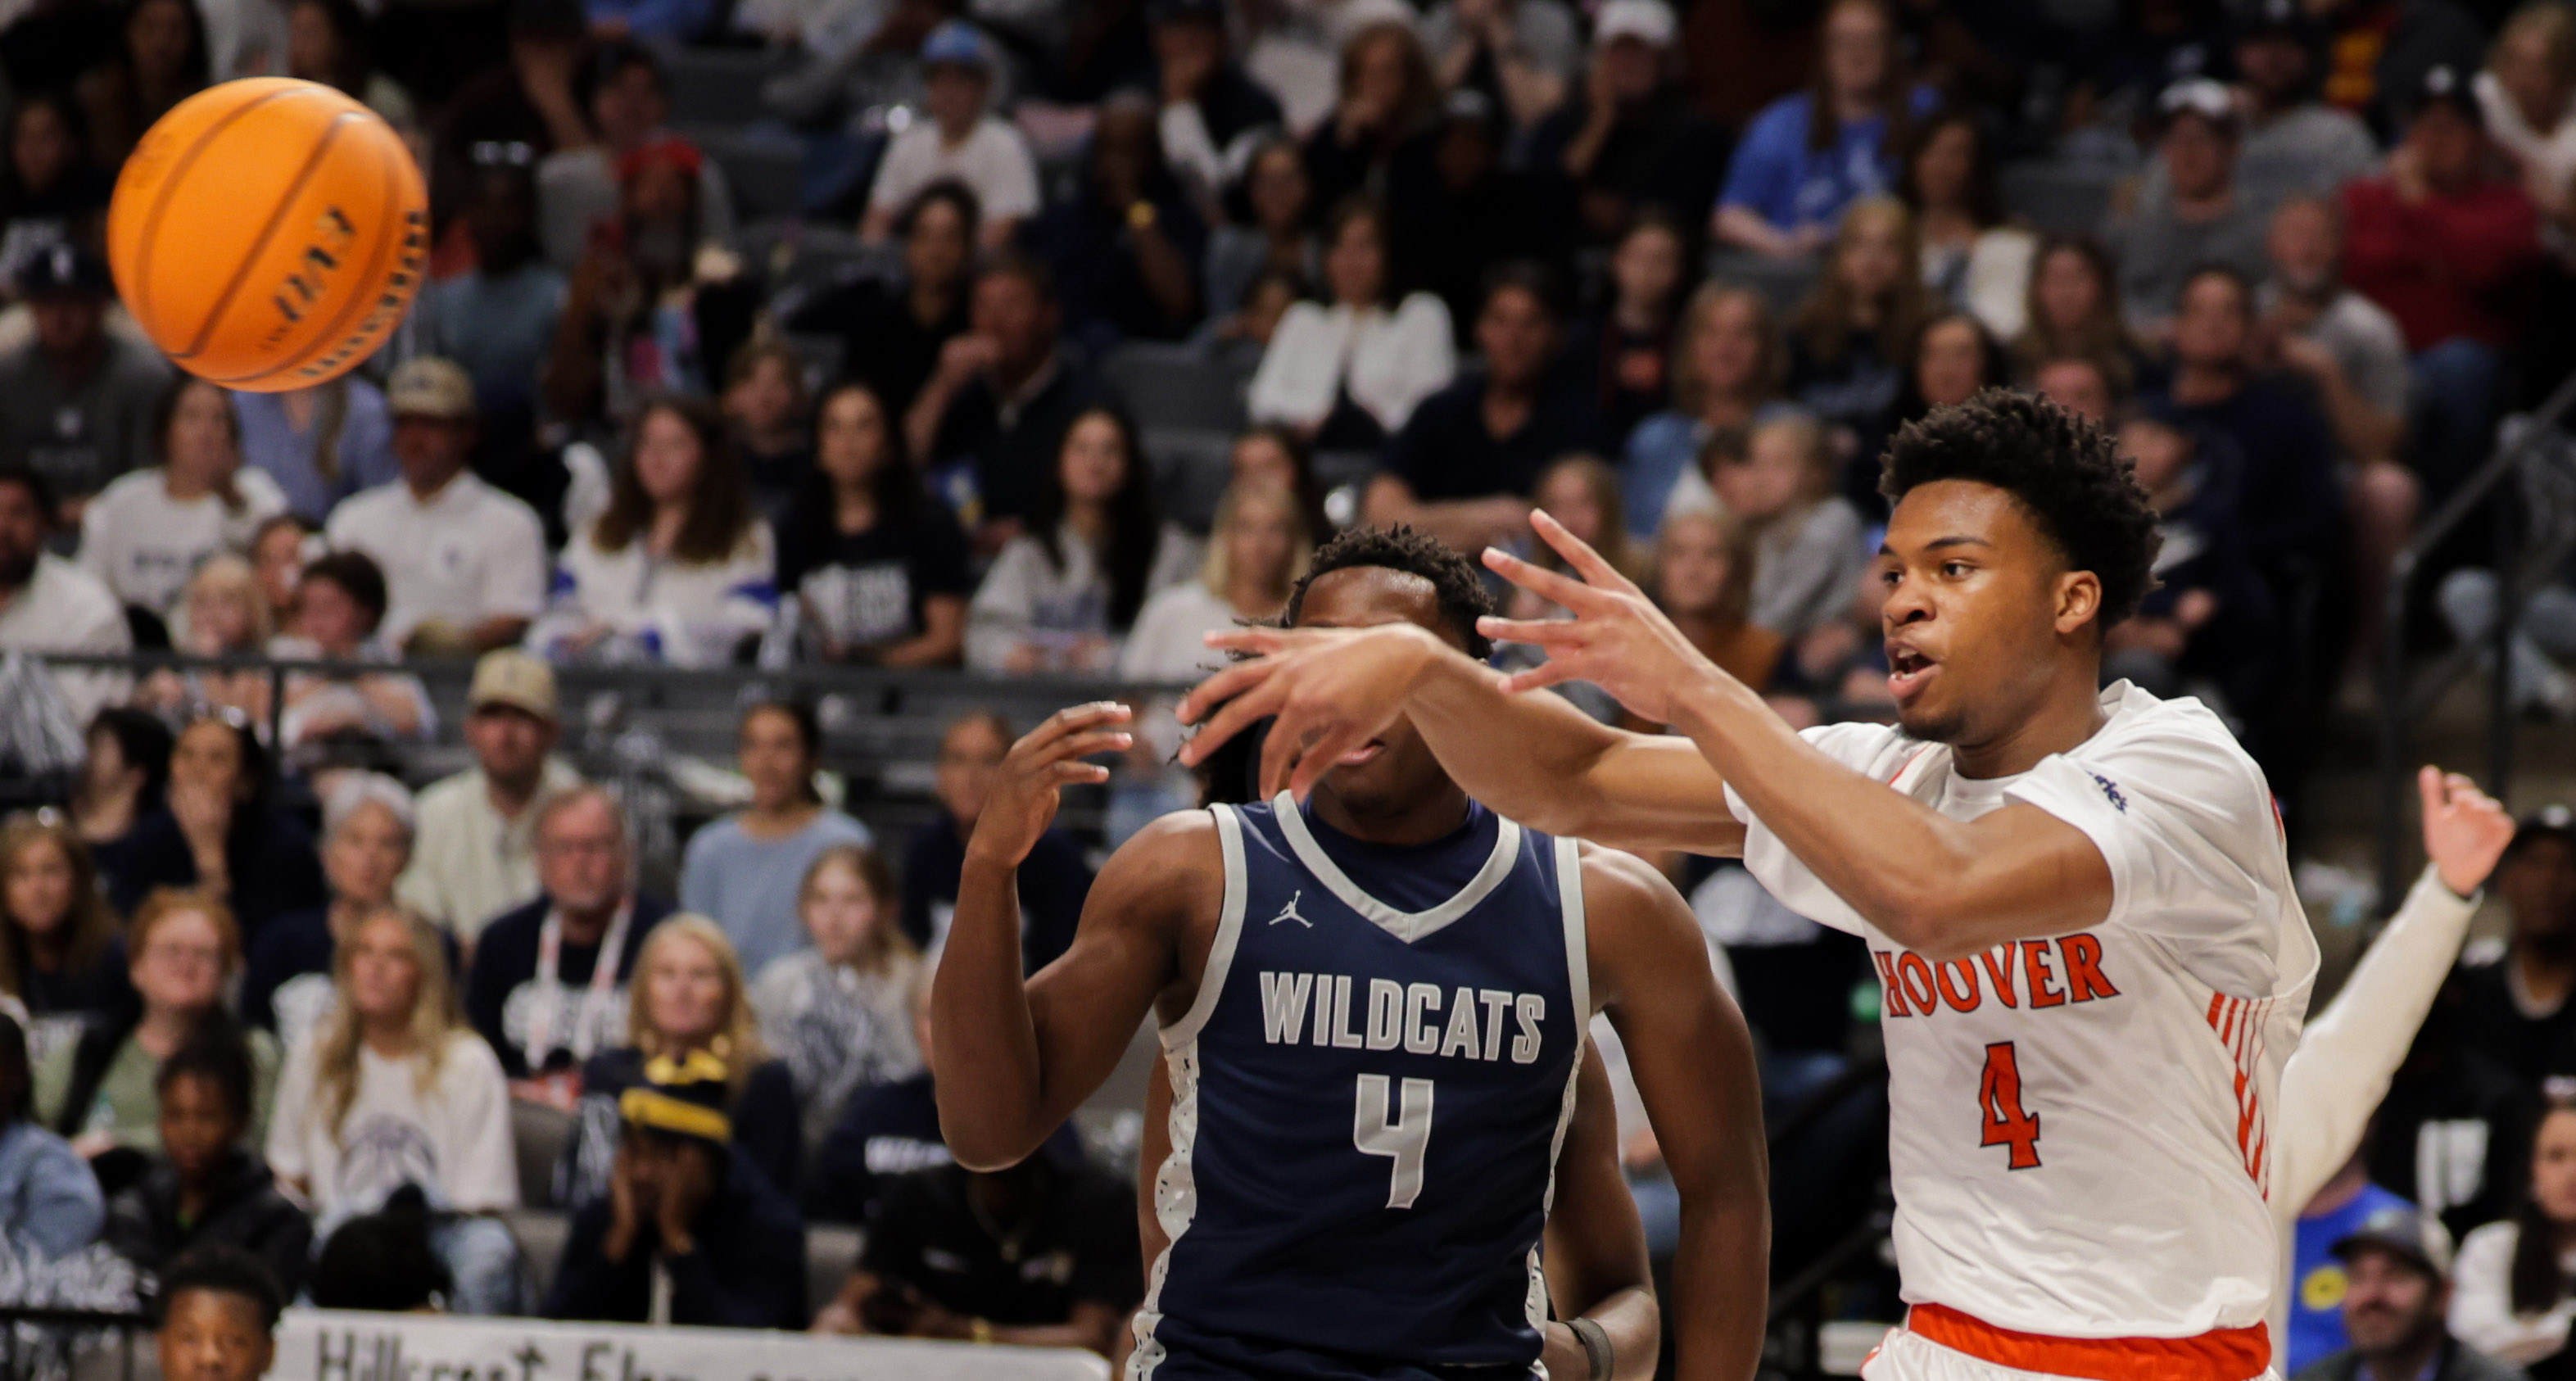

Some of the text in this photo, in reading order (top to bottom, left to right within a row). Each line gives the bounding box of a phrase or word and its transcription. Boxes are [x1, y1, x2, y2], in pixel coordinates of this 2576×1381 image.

[1259, 971, 1545, 1064] WILDCATS
[1874, 932, 2121, 1017] HOOVER
[1353, 1073, 1434, 1209] 4
[1979, 1040, 2042, 1170] 4
